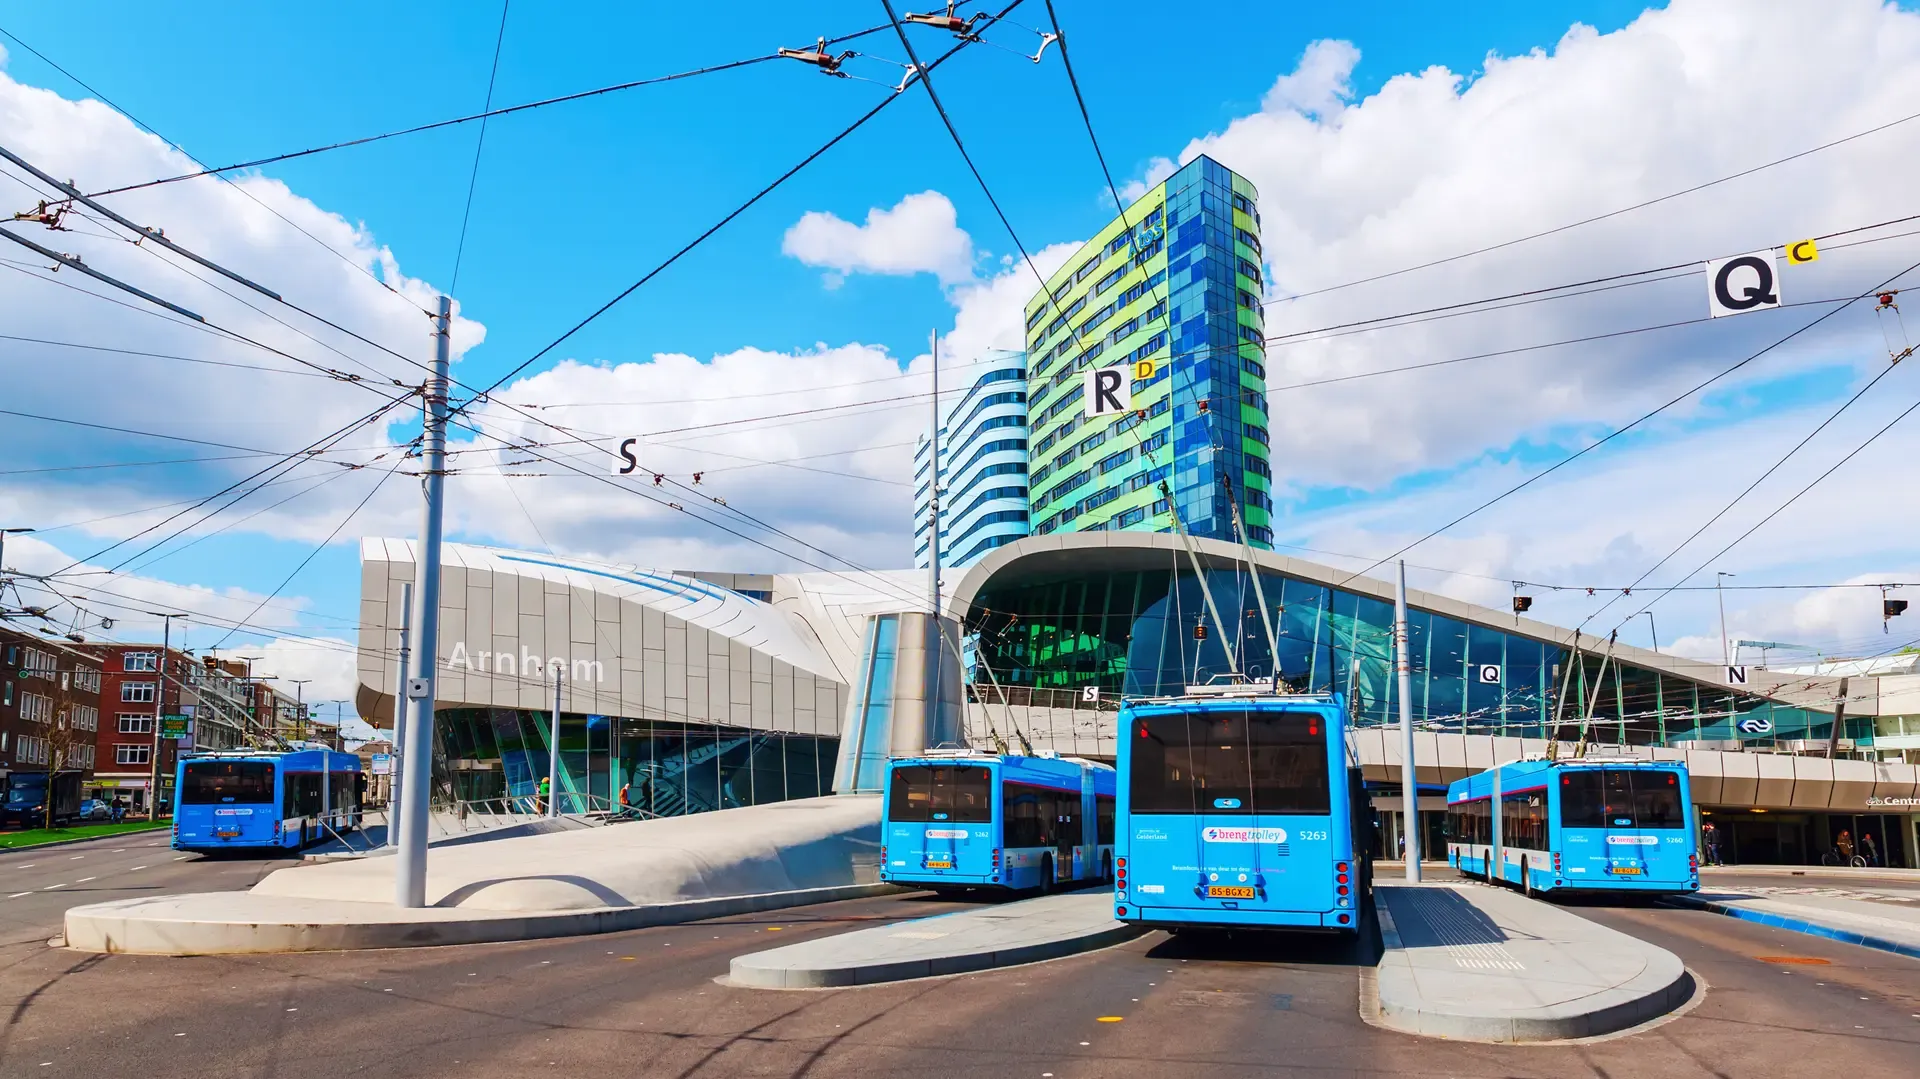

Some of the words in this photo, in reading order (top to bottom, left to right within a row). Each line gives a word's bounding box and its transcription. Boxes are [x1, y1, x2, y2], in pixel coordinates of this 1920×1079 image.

[1127, 219, 1163, 259] Atos
[1792, 242, 1812, 262] C
[1715, 256, 1777, 310] Q
[1138, 361, 1153, 378] D
[1095, 370, 1124, 413] R
[620, 438, 637, 474] S
[447, 641, 604, 683] Arnhem
[1482, 665, 1498, 682] Q
[1728, 666, 1746, 683] N
[1086, 687, 1095, 700] S
[1884, 797, 1920, 805] Centr
[1219, 829, 1281, 842] brengtrolley
[1300, 831, 1327, 841] 5263
[1211, 887, 1251, 897] 85-BGX-2
